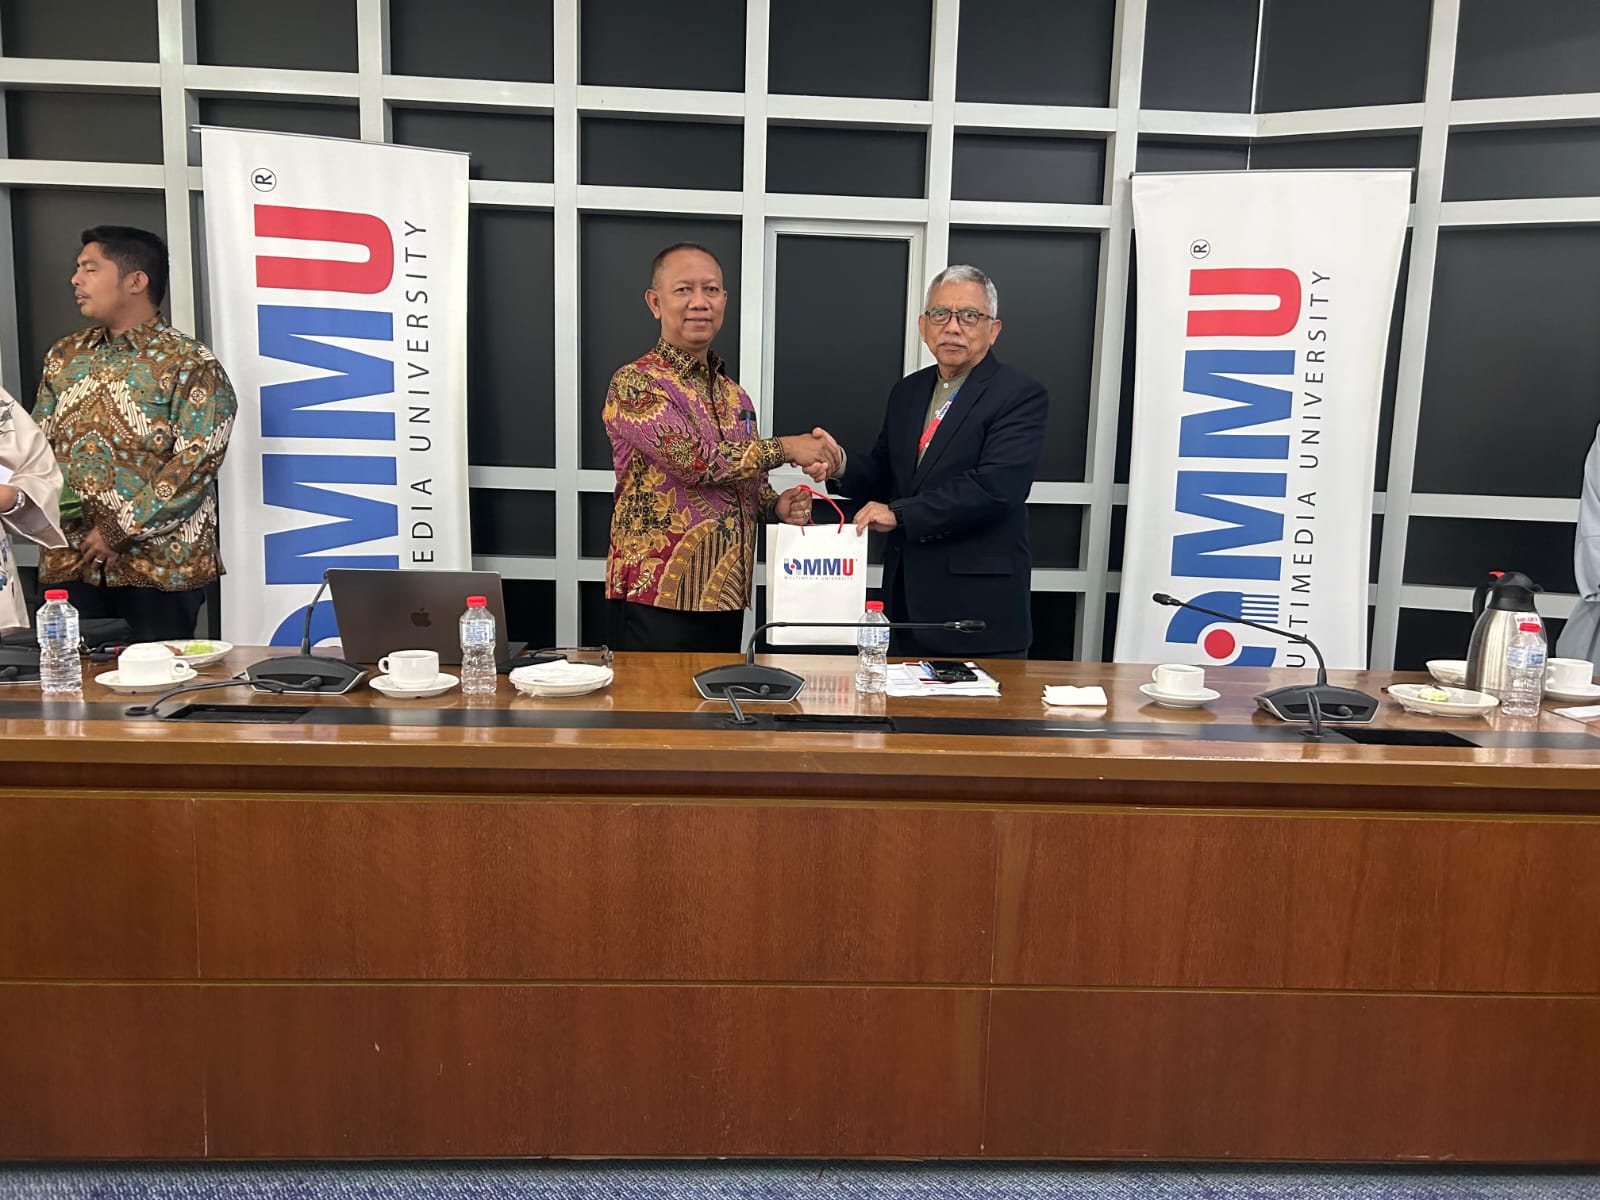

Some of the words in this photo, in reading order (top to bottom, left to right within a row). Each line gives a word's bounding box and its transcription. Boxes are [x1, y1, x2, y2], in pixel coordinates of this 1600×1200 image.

[254, 203, 399, 585] MMU
[403, 220, 433, 452] UNIVERSITY
[1170, 267, 1302, 582] MMU
[1299, 270, 1331, 469] UNIVERSITY
[411, 477, 434, 563] EDIA
[803, 558, 854, 577] MMU
[1286, 491, 1317, 668] ULTIMEDIA
